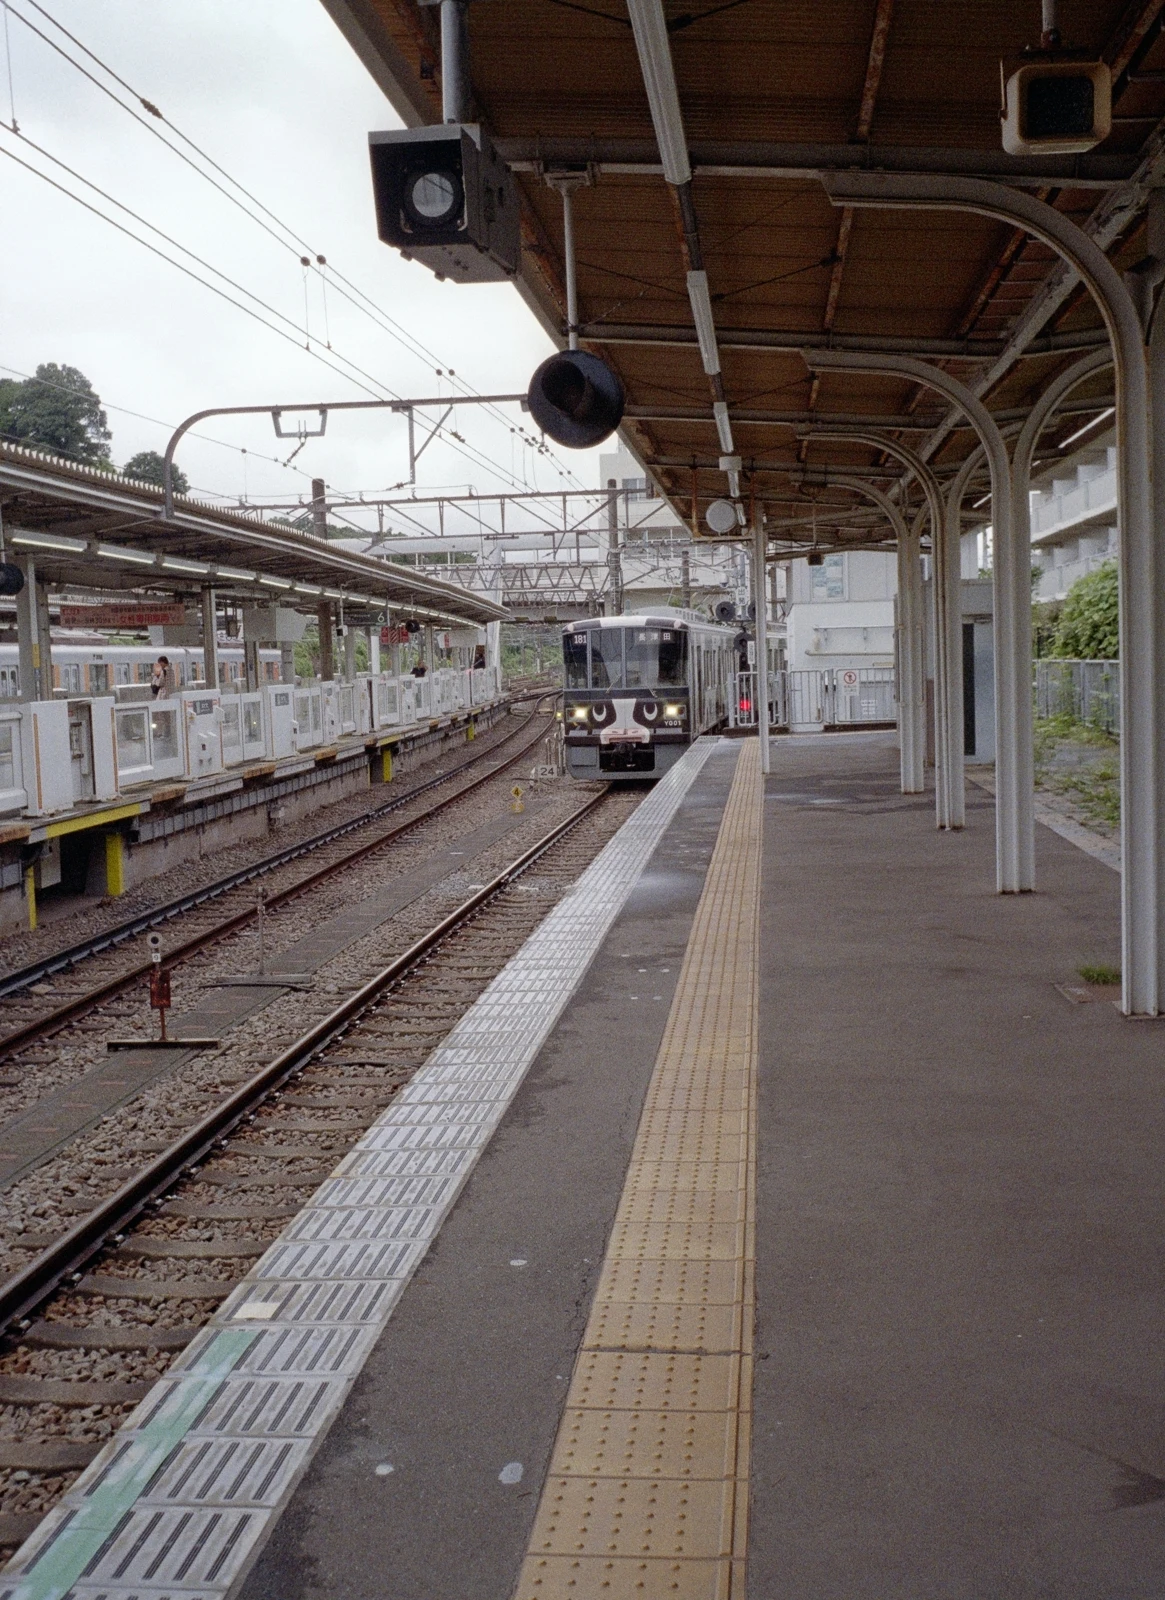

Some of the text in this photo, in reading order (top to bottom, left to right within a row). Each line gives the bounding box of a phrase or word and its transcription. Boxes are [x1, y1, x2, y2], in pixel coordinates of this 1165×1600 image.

[738, 588, 745, 605] 出発
[377, 611, 385, 623] 6
[638, 632, 671, 642] 長津田
[540, 766, 555, 776] 24
[513, 787, 519, 796] 4
